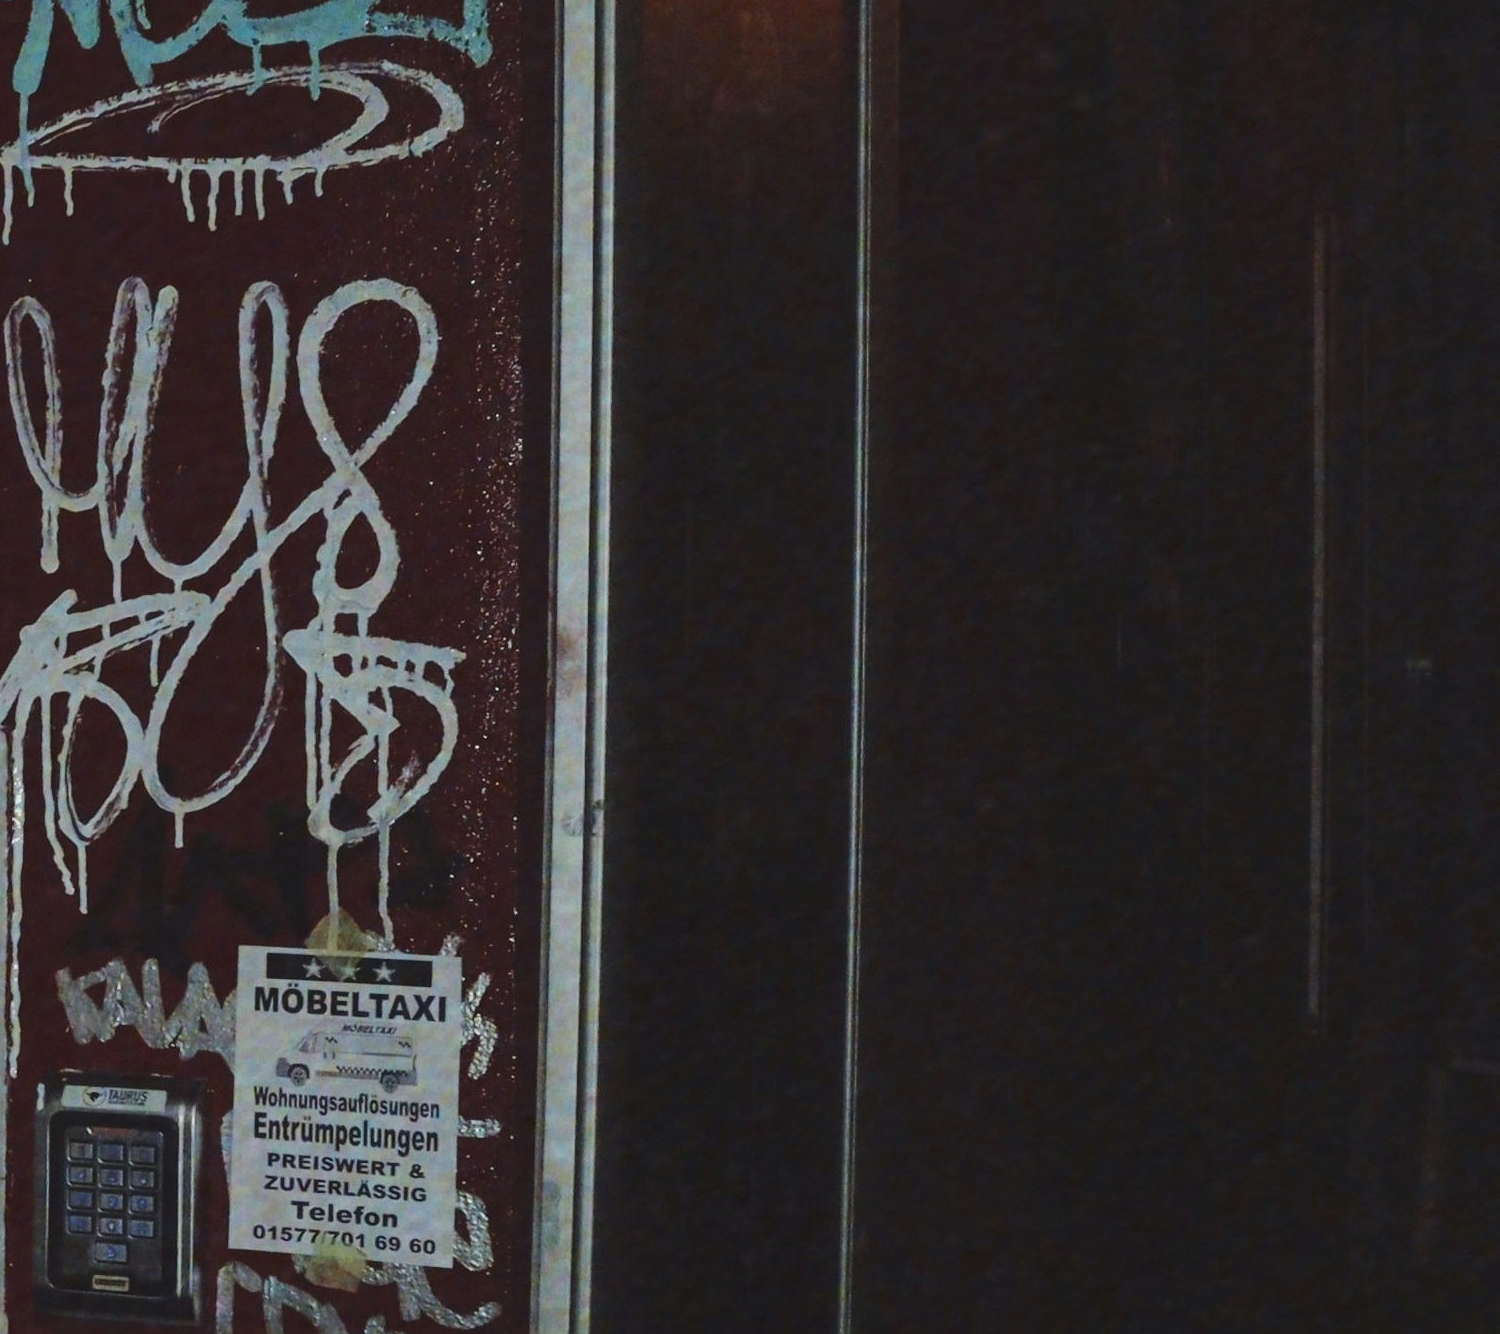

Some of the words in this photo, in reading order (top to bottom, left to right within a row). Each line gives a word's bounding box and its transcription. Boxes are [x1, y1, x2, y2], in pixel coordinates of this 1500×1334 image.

[254, 983, 446, 1022] MÖBELTAXI
[341, 1024, 397, 1035] MÖBELTAXI
[108, 1089, 148, 1104] TAURUS
[254, 1086, 440, 1122] Wohnungsauflösungen
[254, 1112, 439, 1157] Entrümpelungen
[267, 1152, 400, 1176] PREISWERT
[409, 1164, 425, 1178] &
[264, 1175, 427, 1202] ZUVERLÄSSIG
[291, 1200, 398, 1228] Telefon
[375, 1235, 400, 1251] 69
[409, 1238, 436, 1254] 60
